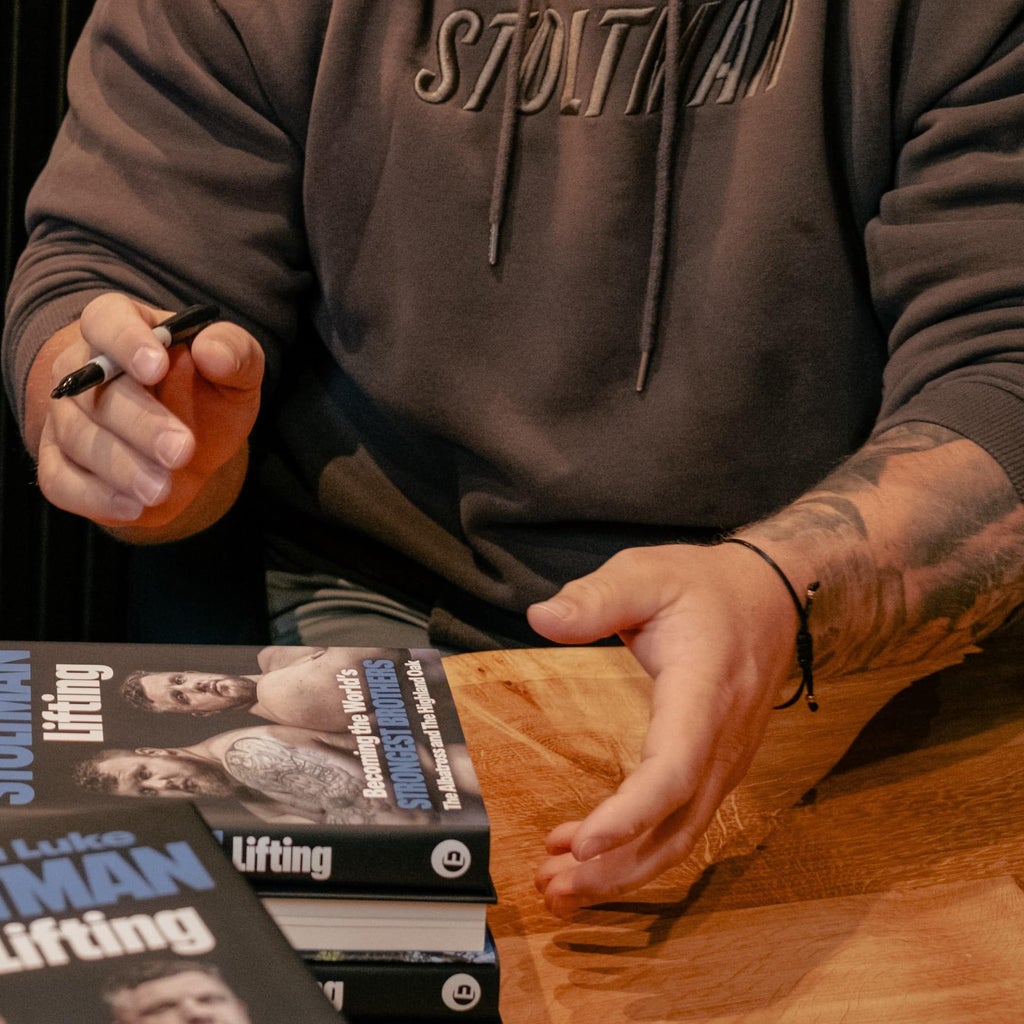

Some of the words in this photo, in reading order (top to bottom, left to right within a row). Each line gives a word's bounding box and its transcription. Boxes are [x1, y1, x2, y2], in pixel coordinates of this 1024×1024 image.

[404, 659, 424, 676] Oak
[41, 664, 114, 742] Lifting
[336, 668, 367, 713] World's
[362, 659, 410, 726] BROTHERS
[408, 677, 436, 713] Highland
[347, 714, 372, 735] the
[421, 713, 439, 730] The
[422, 730, 445, 749] and
[353, 736, 388, 798] Becoming
[379, 727, 432, 810] STRONGEST
[432, 748, 457, 792] Albatross
[442, 792, 462, 810] The
[10, 829, 137, 861] Luke
[232, 836, 332, 881] Lifting
